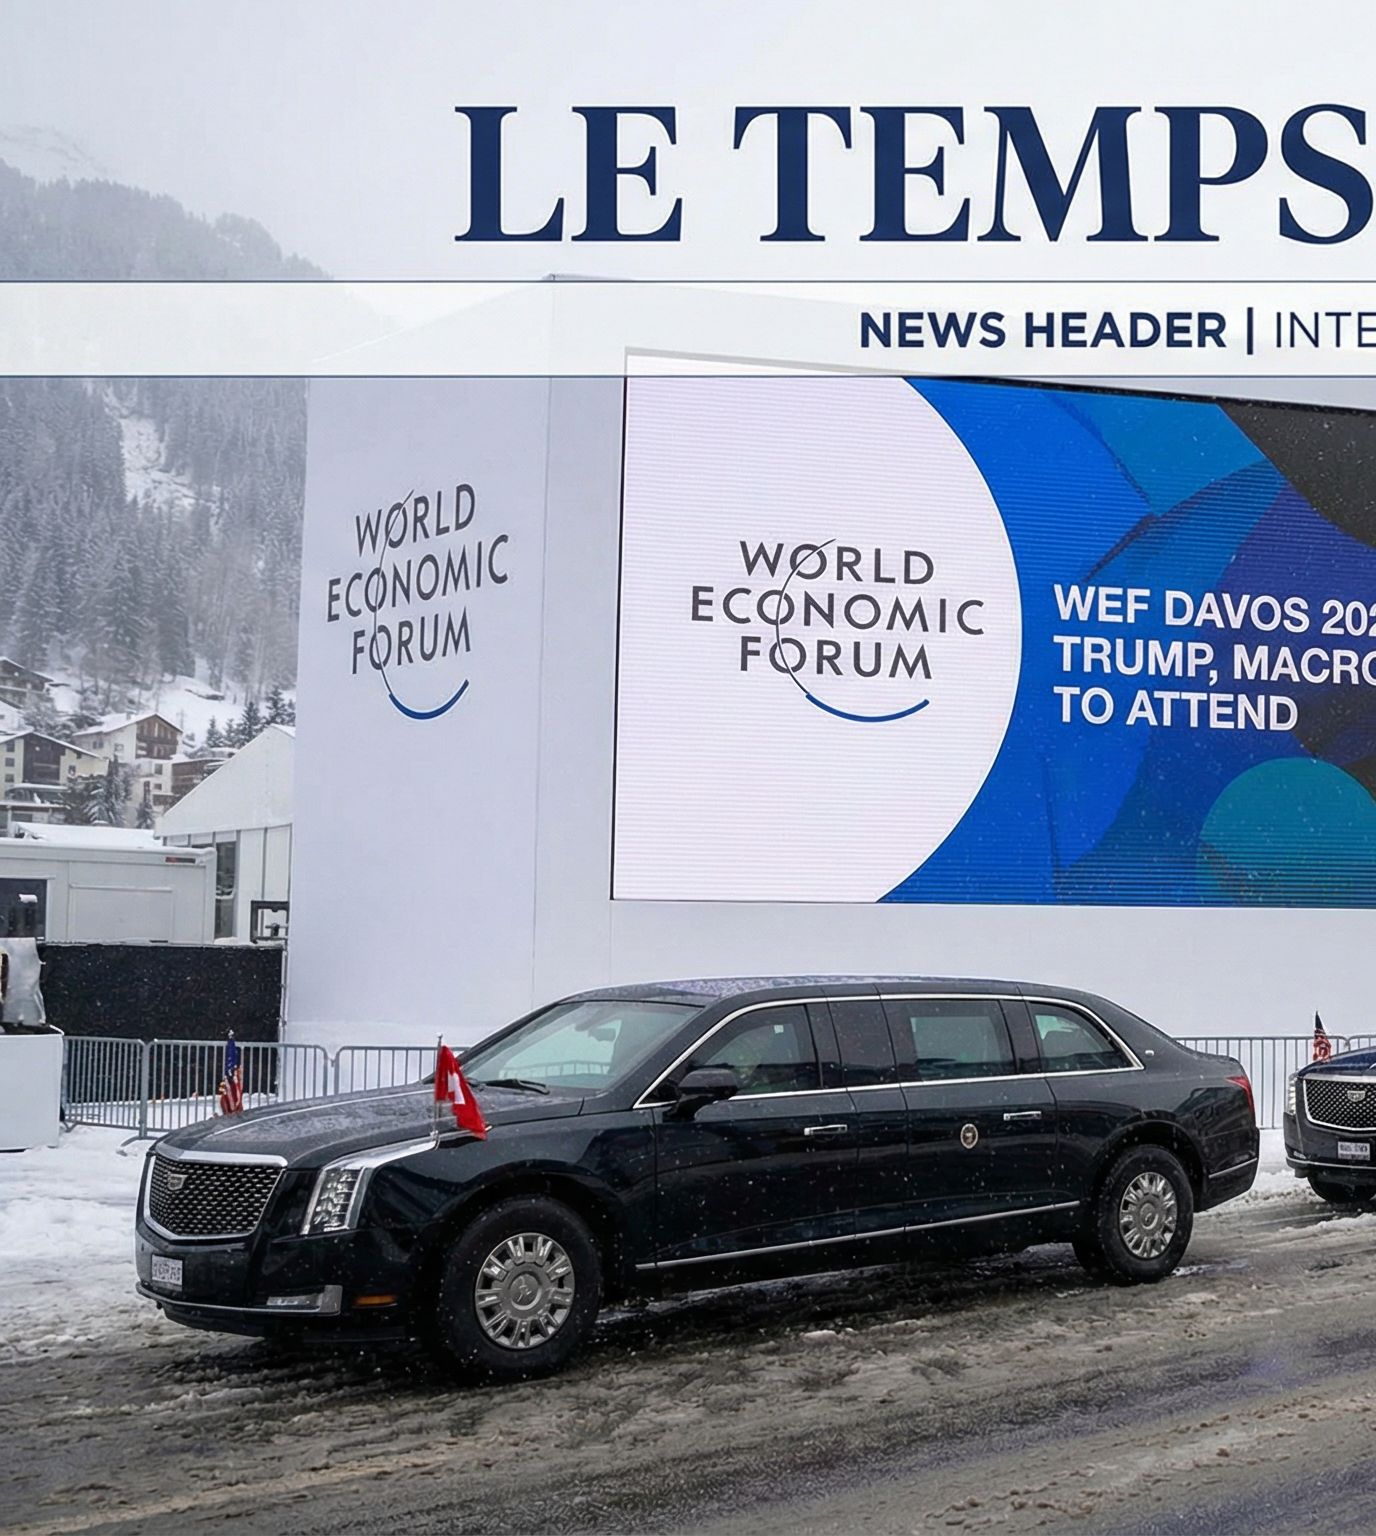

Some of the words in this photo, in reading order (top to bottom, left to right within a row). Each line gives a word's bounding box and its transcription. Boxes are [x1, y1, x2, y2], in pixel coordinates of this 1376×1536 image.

[356, 484, 475, 557] WORLD
[327, 534, 508, 622] ECONOMIC
[739, 540, 934, 584] WORLD
[691, 586, 984, 635] ECONOMIC
[1054, 584, 1150, 623] WEF
[1166, 591, 1310, 632] DAVOS
[352, 606, 470, 674] FORUM
[740, 636, 932, 679] FORUM
[1053, 636, 1218, 687] TRUMP,
[1054, 687, 1114, 724] TO
[1126, 691, 1298, 730] ATTEND
